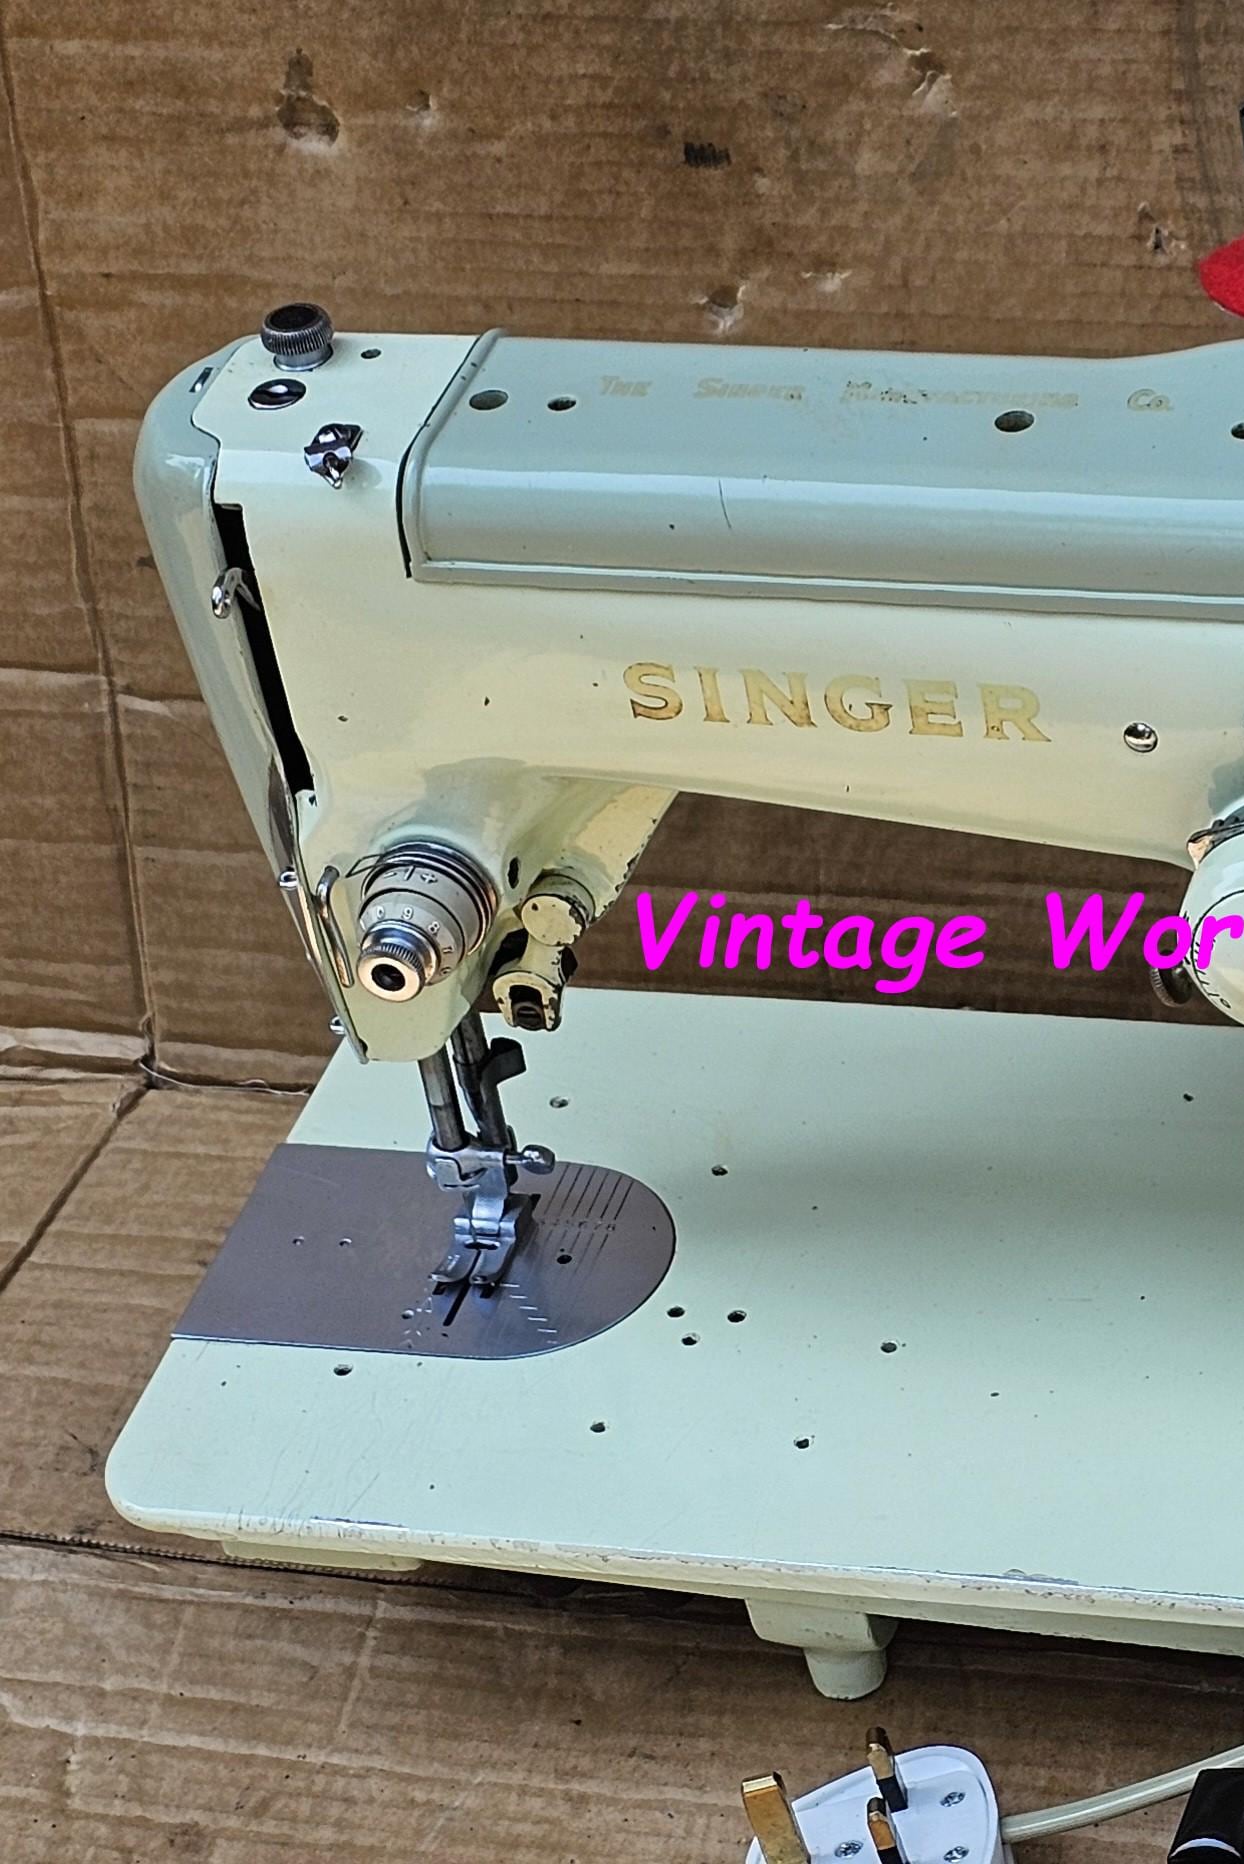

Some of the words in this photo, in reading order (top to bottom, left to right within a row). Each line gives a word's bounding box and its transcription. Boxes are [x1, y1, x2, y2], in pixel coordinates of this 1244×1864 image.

[623, 662, 1052, 742] SINGER
[402, 906, 414, 920] 9
[428, 921, 440, 935] 8
